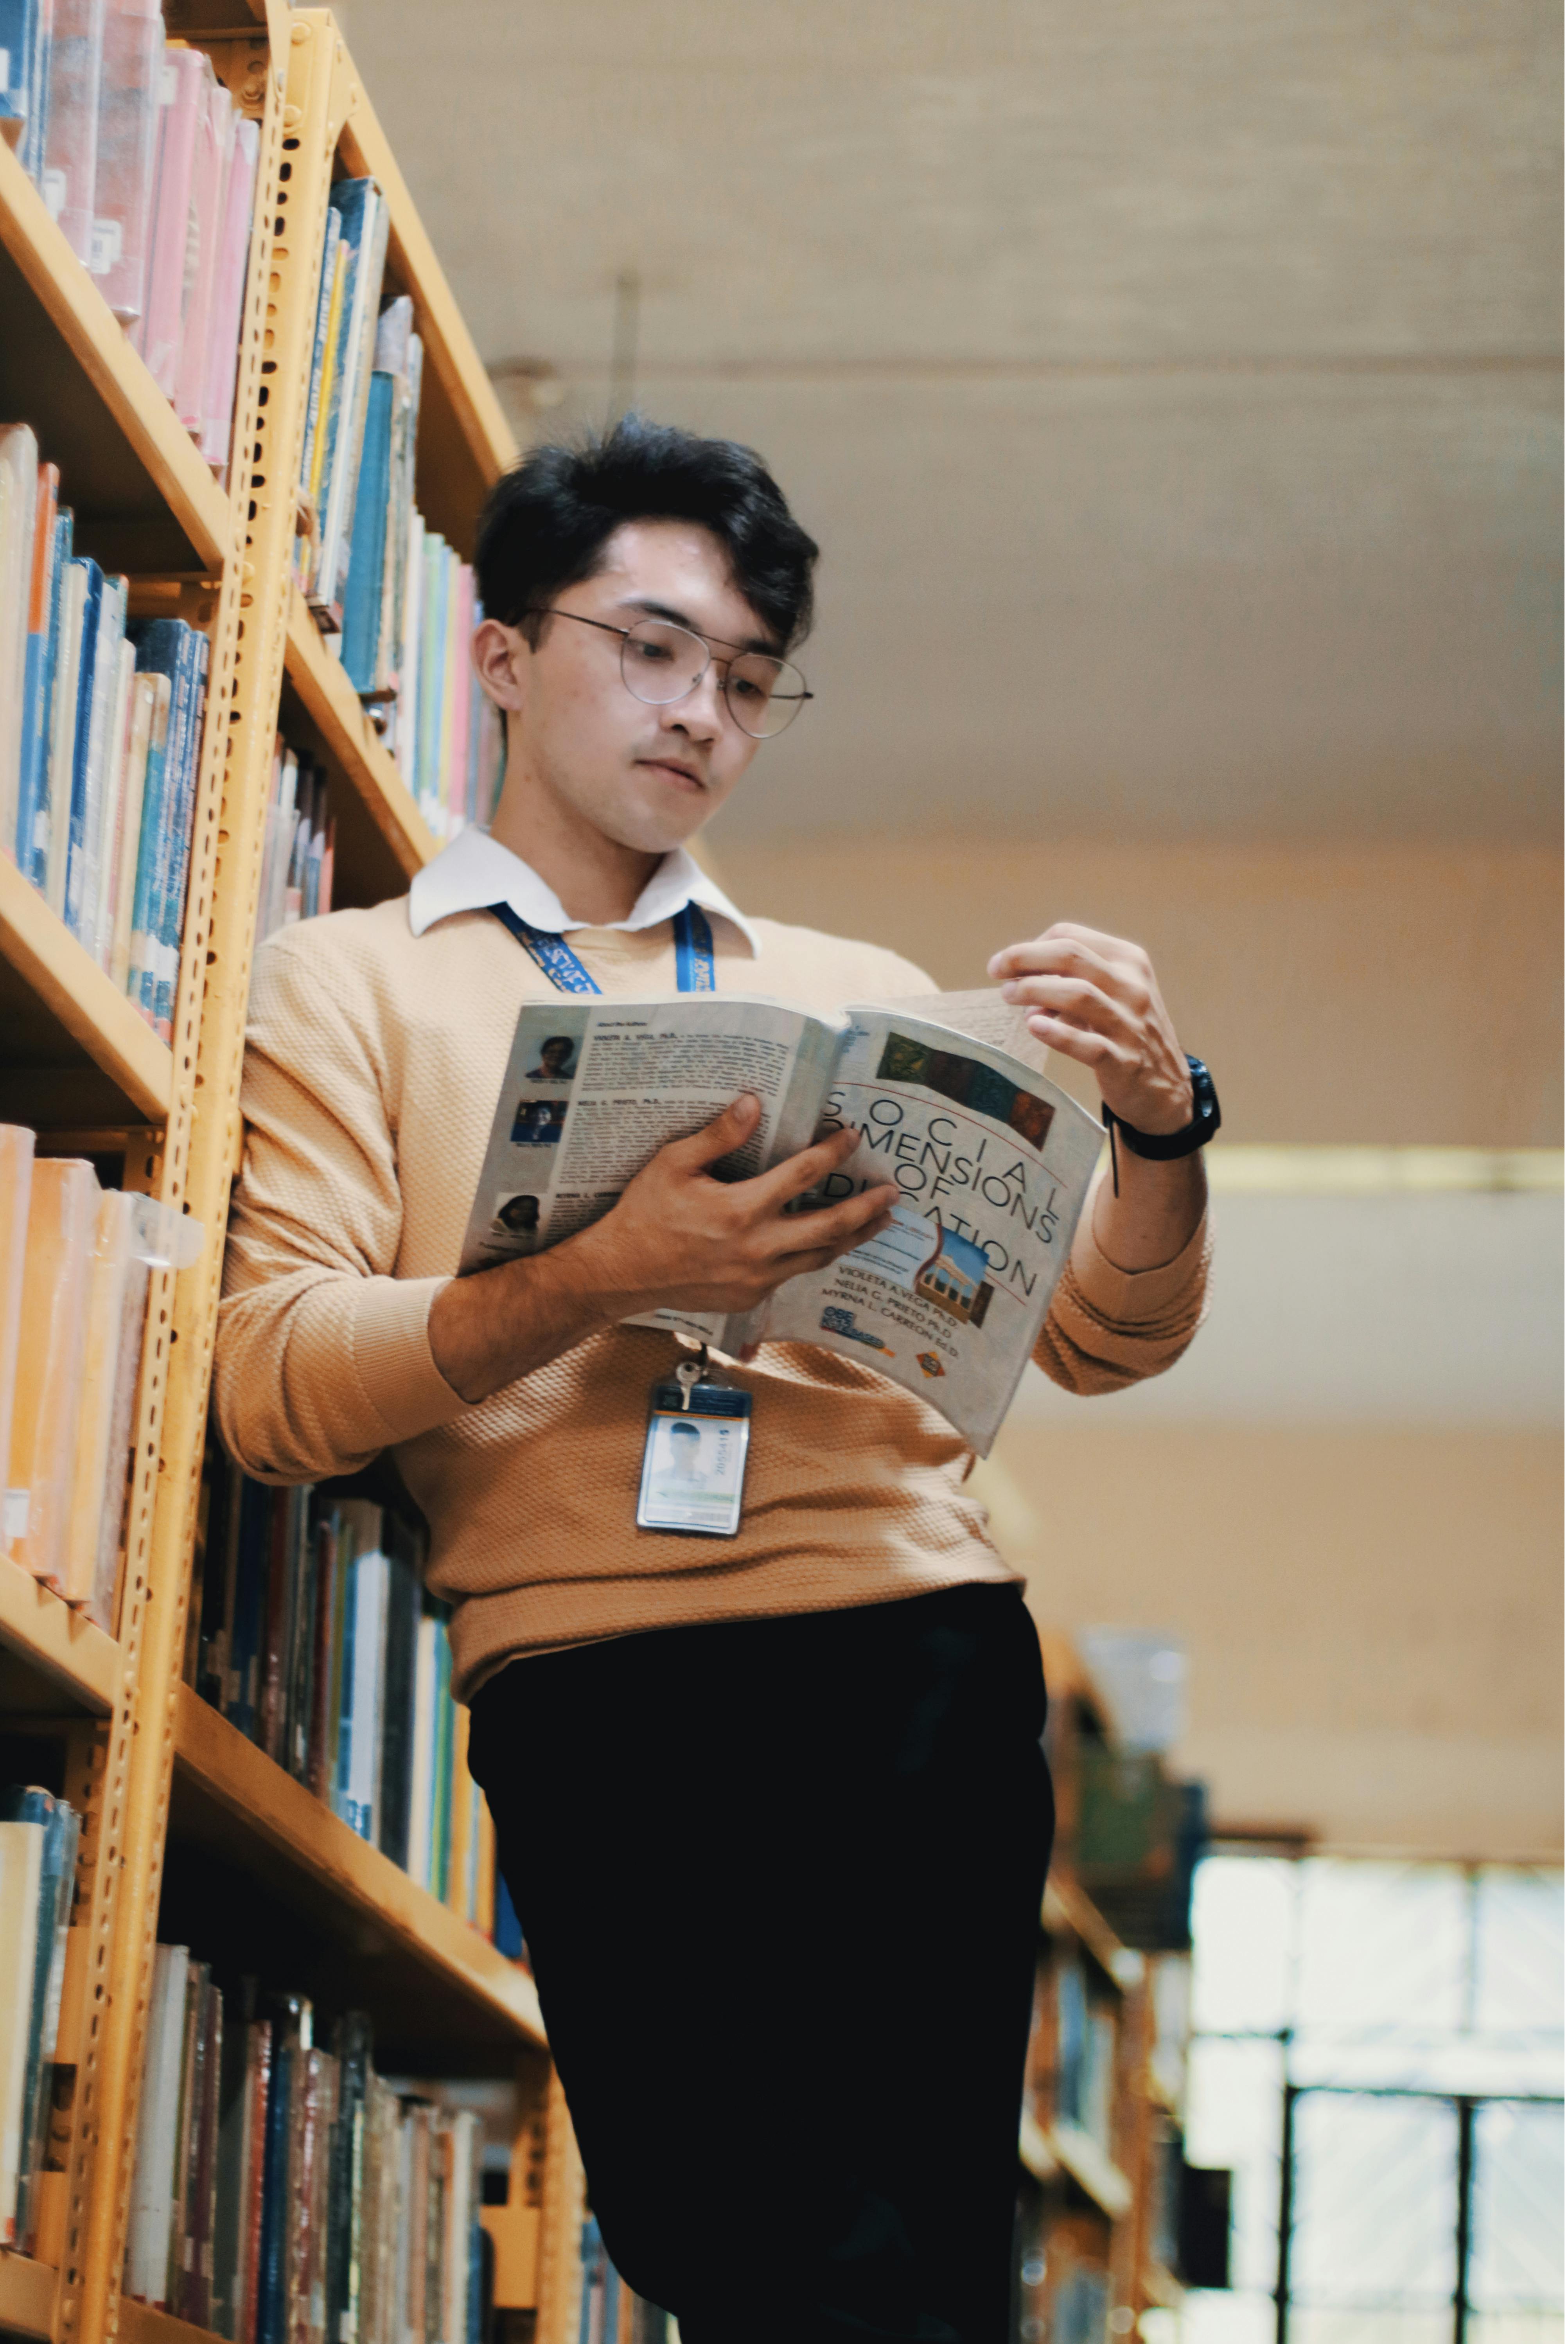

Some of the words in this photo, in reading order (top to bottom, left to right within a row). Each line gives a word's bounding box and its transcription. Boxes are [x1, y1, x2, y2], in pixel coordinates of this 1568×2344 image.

[823, 1091, 1059, 1221] SOCIAL
[822, 1118, 1057, 1244] MENSIONS
[894, 1163, 955, 1199] OF
[835, 1278, 868, 1294] NELIA
[887, 1297, 925, 1322] PRIETO
[839, 1266, 887, 1289] VIOLETA
[822, 1288, 865, 1306] MYRNA
[881, 1307, 933, 1340] CARREON
